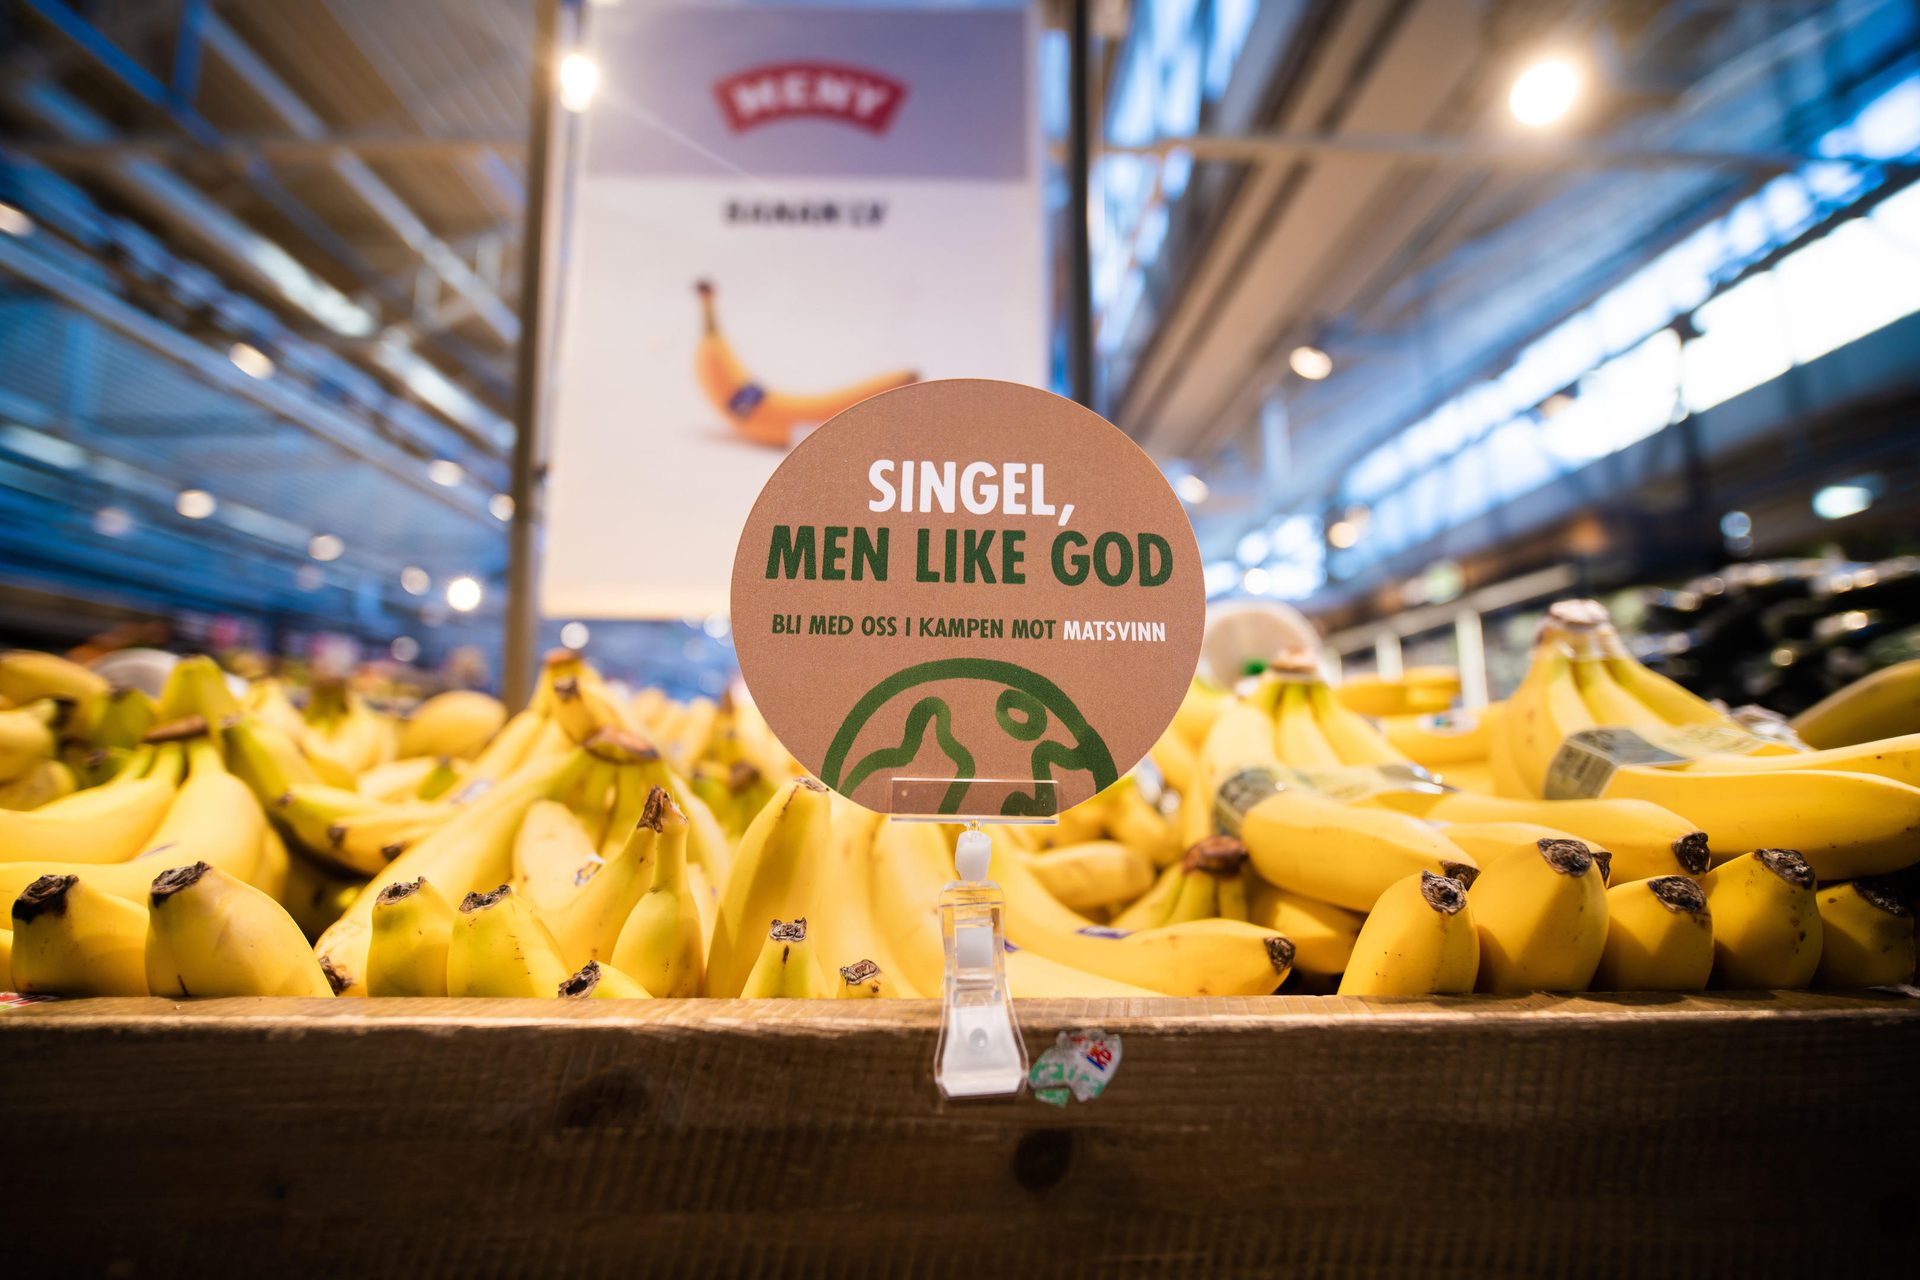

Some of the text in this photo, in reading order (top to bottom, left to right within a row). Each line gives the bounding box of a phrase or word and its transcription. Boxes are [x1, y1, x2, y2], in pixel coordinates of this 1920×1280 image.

[727, 69, 893, 119] MENY
[868, 459, 1075, 527] SINGEL,
[765, 525, 1174, 588] MEN LIKE GOD
[771, 614, 1167, 642] BLI MED OSS I KAMPEN MOT MATSVINN
